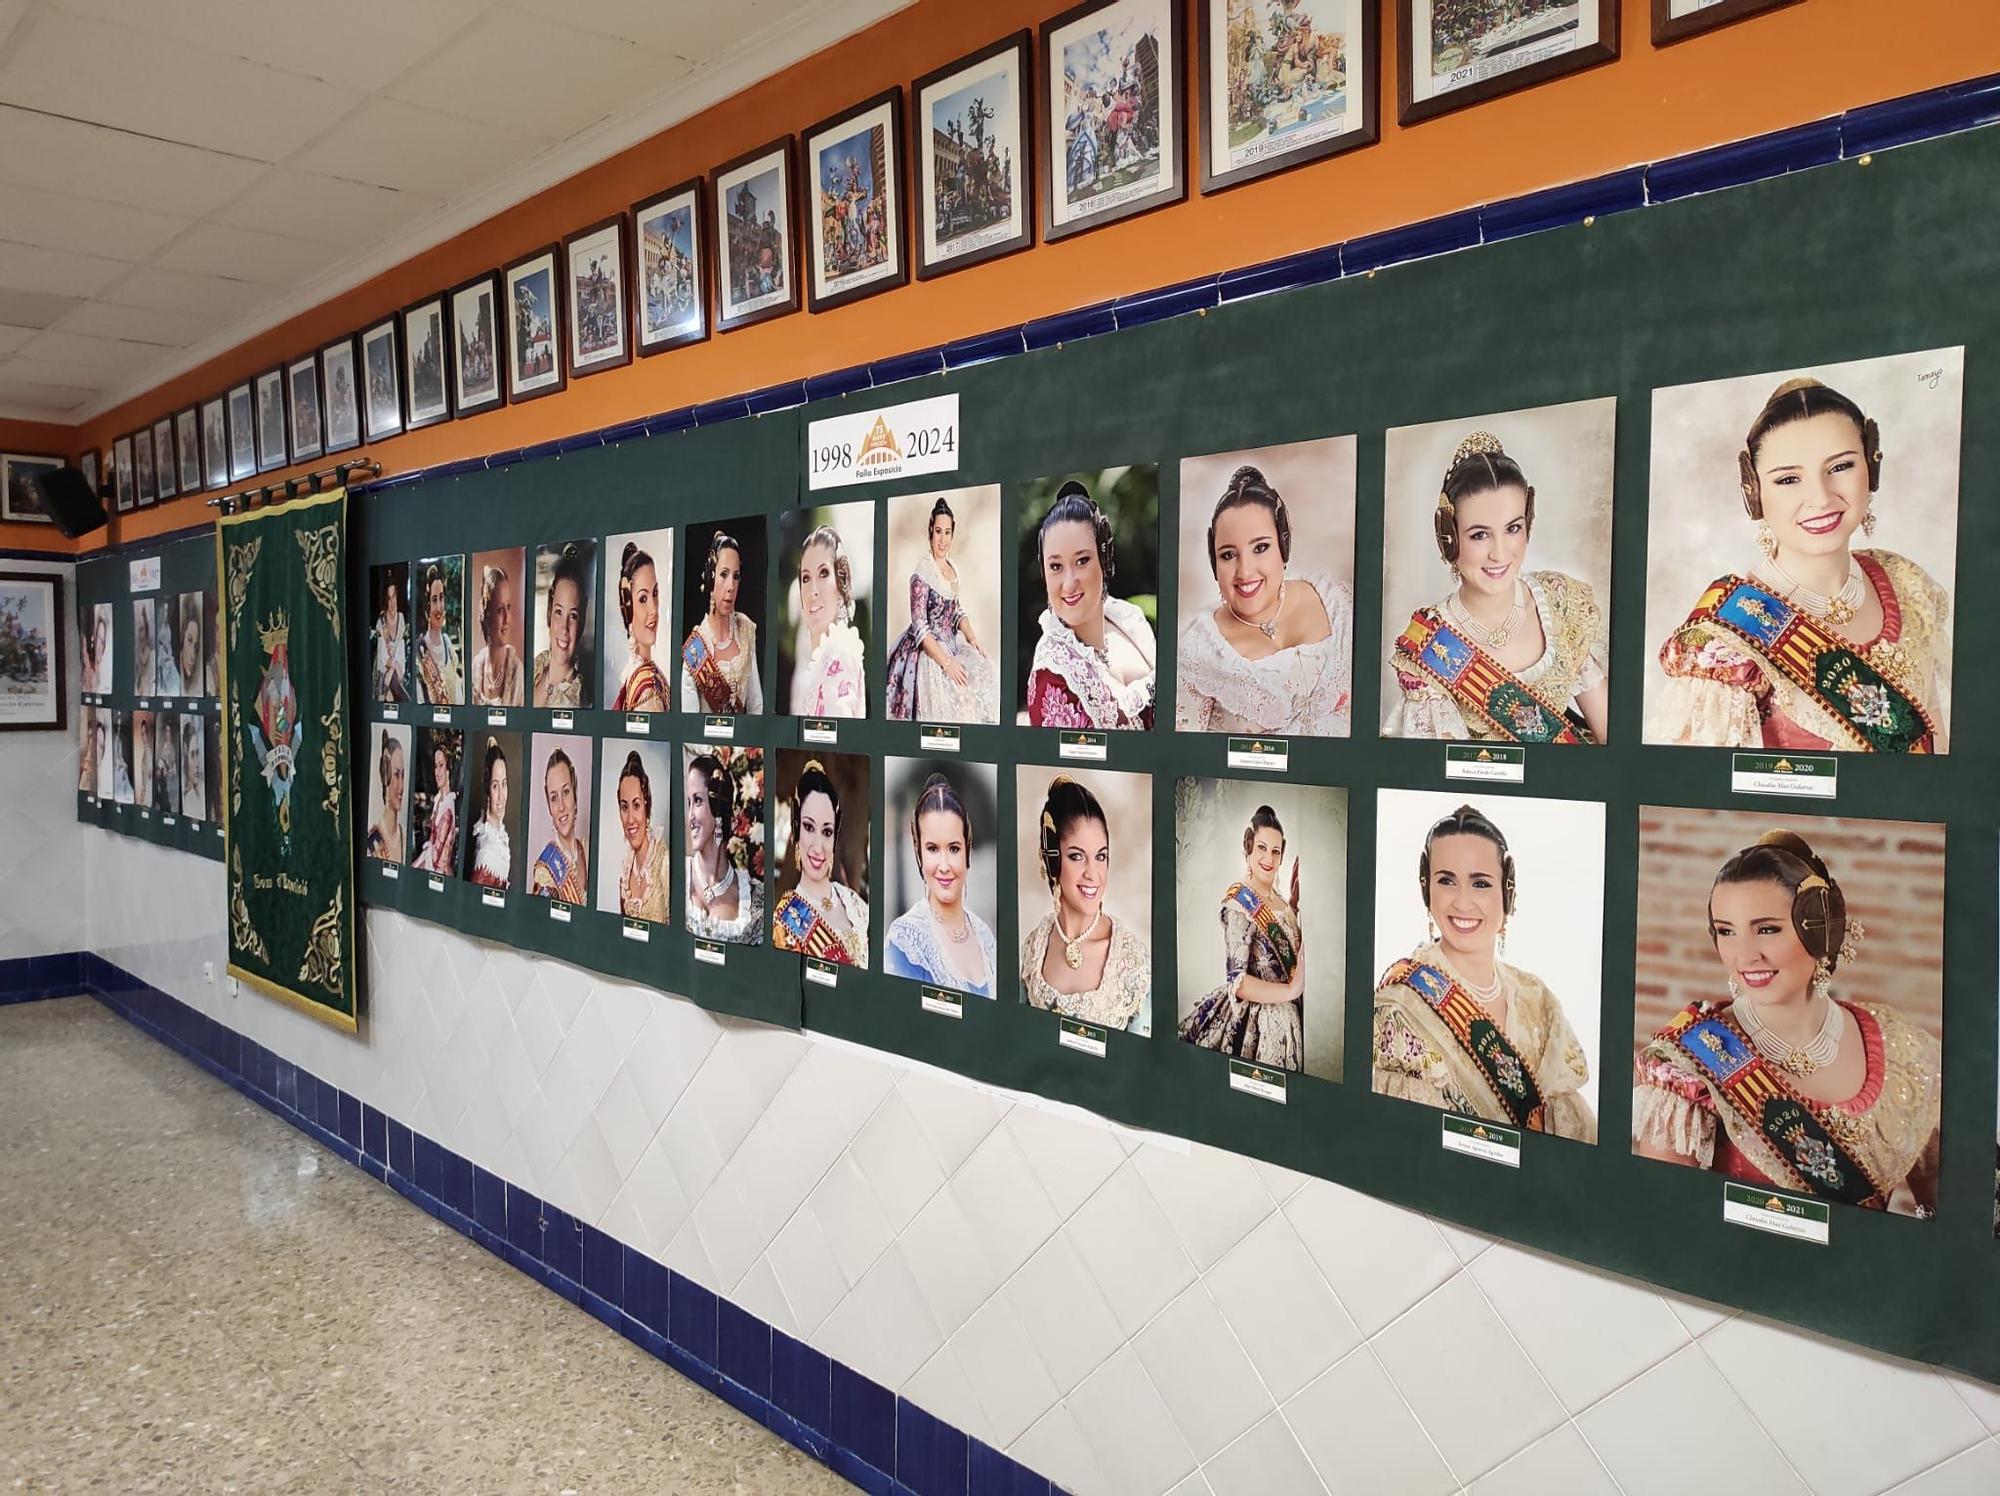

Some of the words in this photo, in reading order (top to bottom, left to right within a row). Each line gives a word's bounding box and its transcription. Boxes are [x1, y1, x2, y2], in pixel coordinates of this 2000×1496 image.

[1450, 67, 1473, 82] 2021
[1245, 144, 1264, 157] 2019
[813, 443, 851, 473] 1998
[907, 425, 955, 459] 2024
[856, 469, 872, 478] Falla
[1822, 656, 1850, 689] 2020
[1754, 761, 1773, 770] 2019
[1794, 763, 1814, 772] 2020
[1478, 1029, 1496, 1054] 2019
[1769, 1108, 1800, 1132] 2020
[1786, 1203, 1805, 1215] 2021
